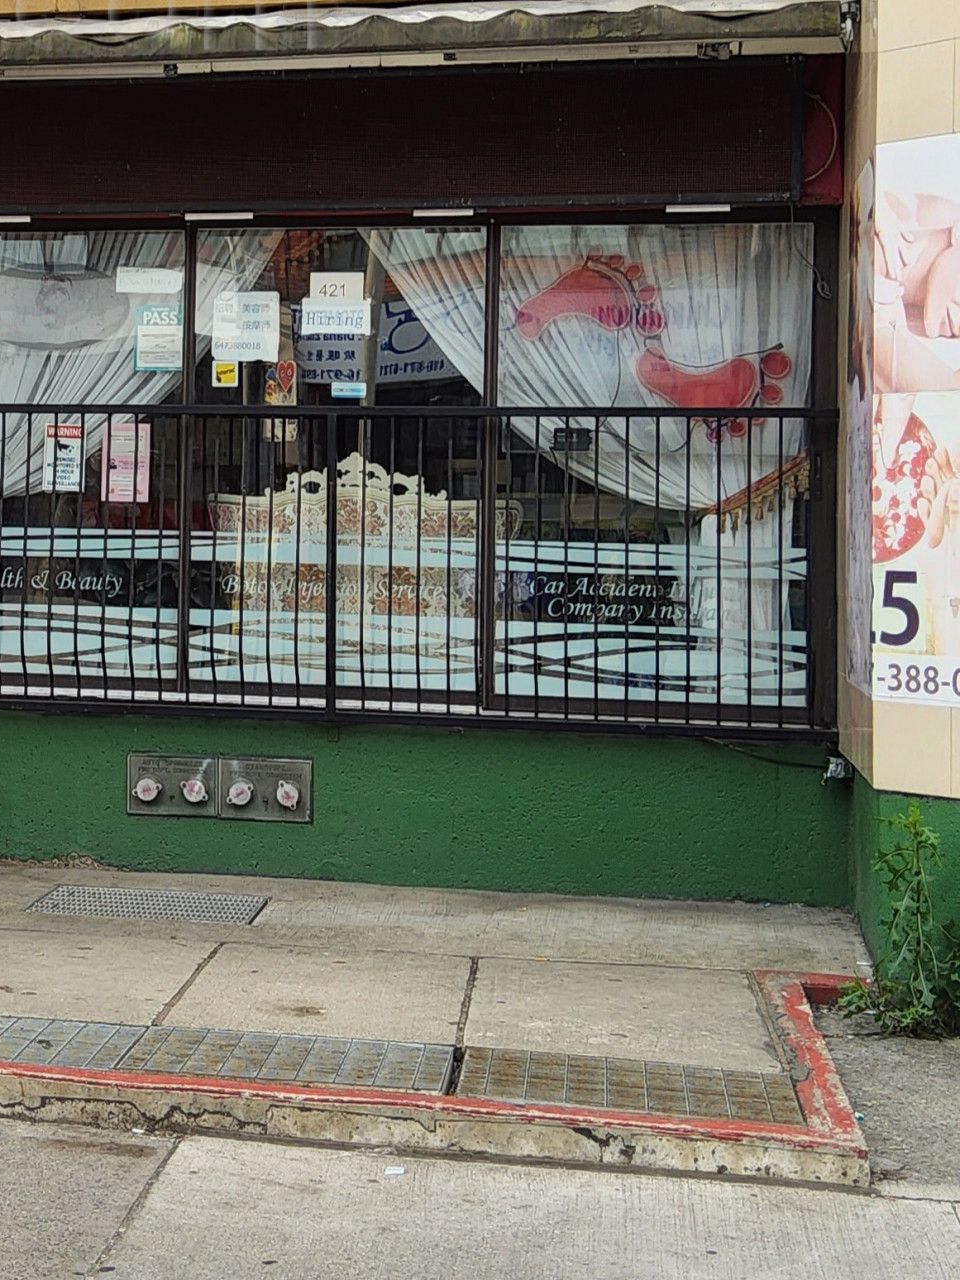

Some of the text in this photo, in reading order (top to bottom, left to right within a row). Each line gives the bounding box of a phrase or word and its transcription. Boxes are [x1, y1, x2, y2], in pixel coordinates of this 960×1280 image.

[319, 284, 346, 297] 421
[143, 311, 178, 325] PASS
[305, 311, 363, 329] Hiring
